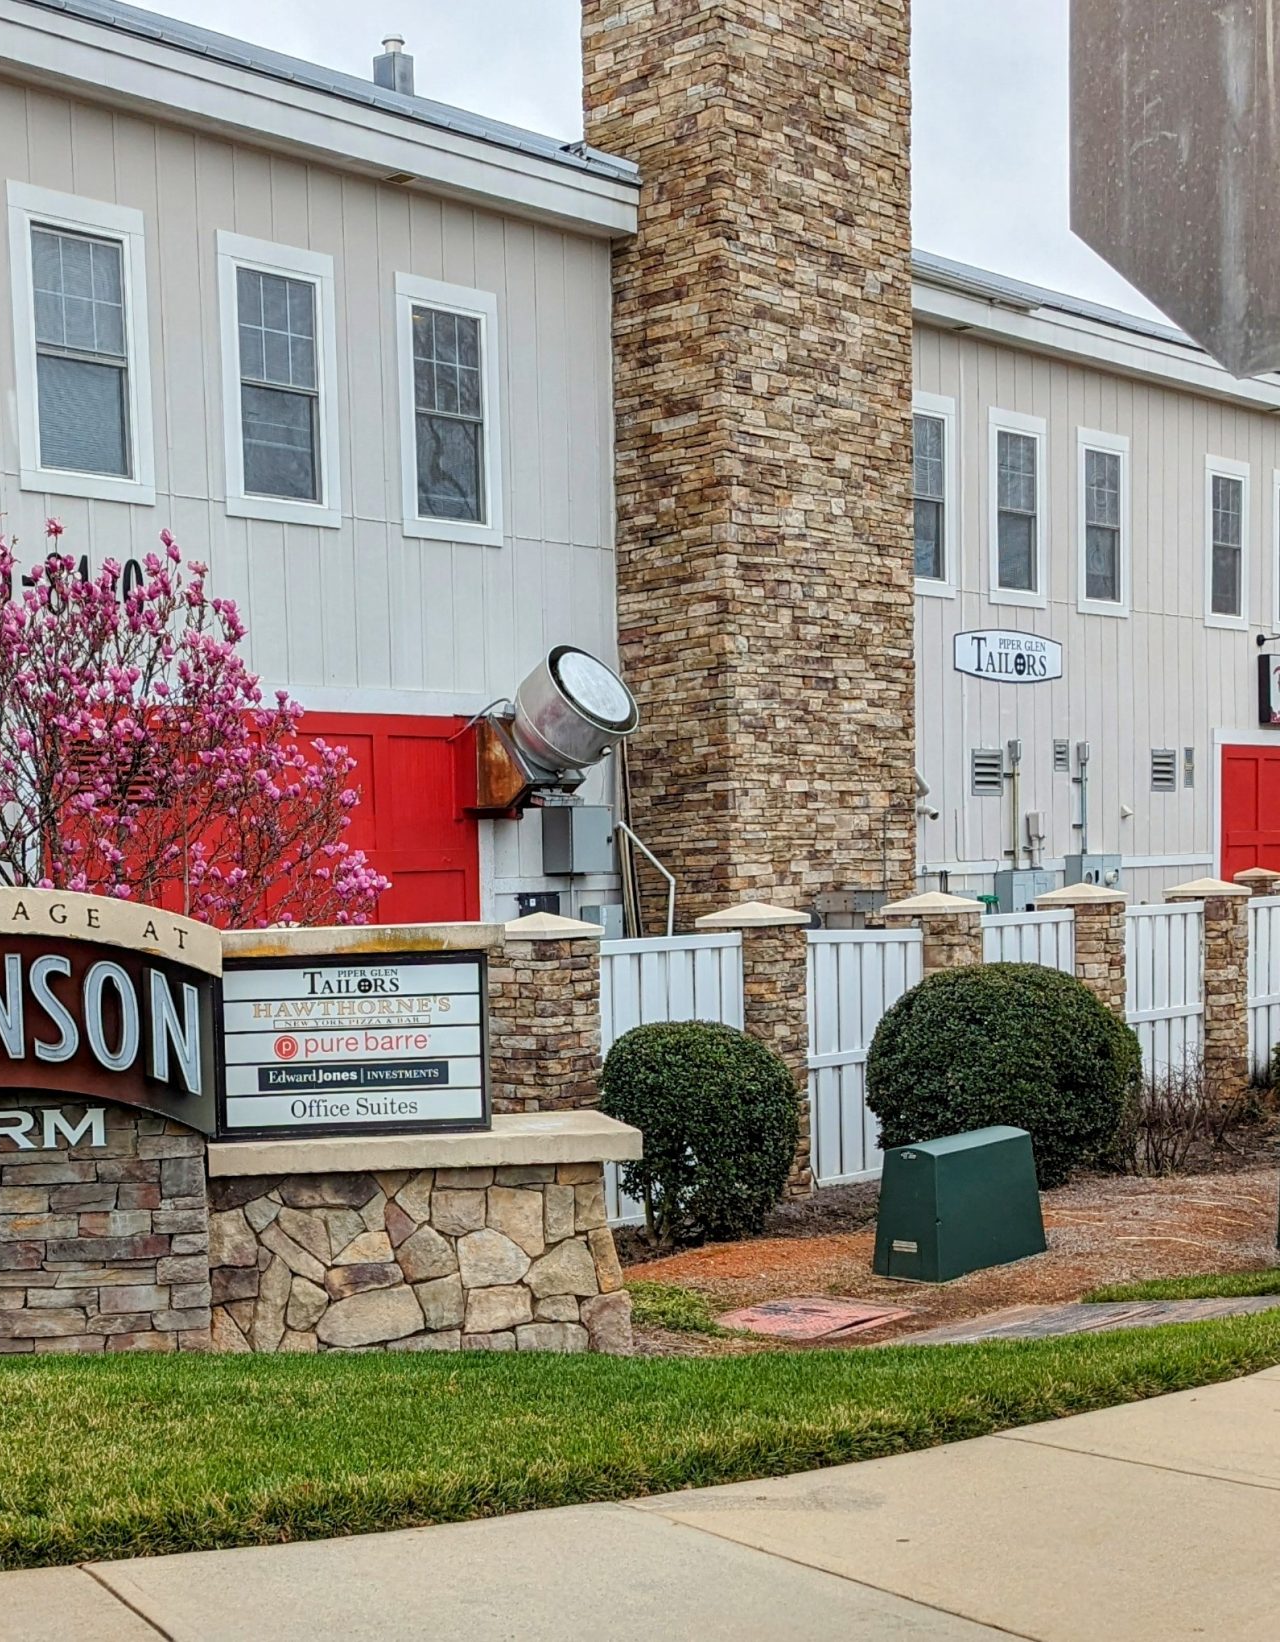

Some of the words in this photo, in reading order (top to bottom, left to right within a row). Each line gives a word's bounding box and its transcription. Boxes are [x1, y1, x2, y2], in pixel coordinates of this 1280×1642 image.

[970, 635, 1047, 677] TAILORS
[998, 638, 1022, 651] PIPER
[1024, 640, 1047, 652] GLEN
[142, 920, 188, 950] AT
[303, 970, 400, 995] TAILORS
[337, 969, 366, 978] PIPER
[370, 968, 398, 977] GLEN
[252, 996, 451, 1019] HAWTHORNE'S
[304, 1035, 359, 1058] pure
[364, 1031, 428, 1051] barre
[366, 1068, 440, 1080] INVESTMENTS
[290, 1098, 350, 1119] Office
[356, 1096, 418, 1116] Suites
